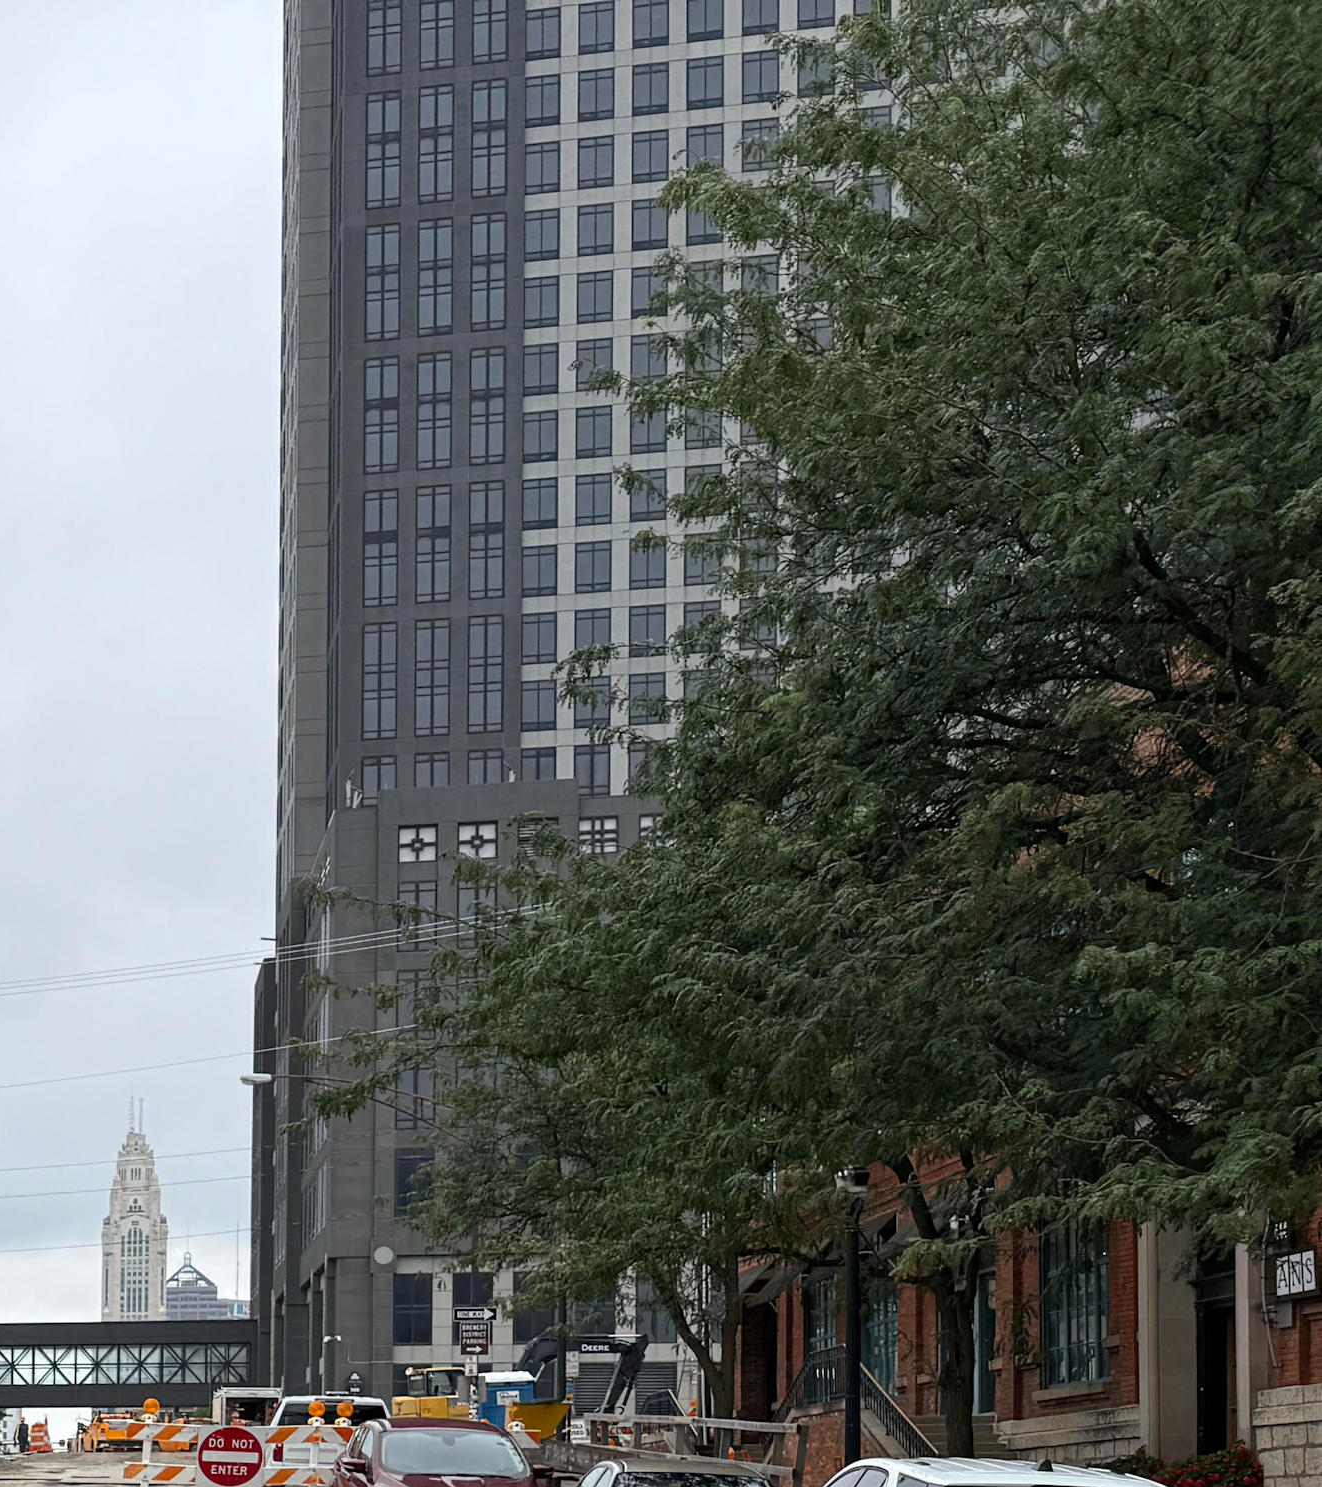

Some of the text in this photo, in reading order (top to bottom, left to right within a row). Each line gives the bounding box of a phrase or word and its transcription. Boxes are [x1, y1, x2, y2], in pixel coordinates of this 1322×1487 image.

[581, 1343, 610, 1351] DEERE
[208, 1437, 255, 1449] DO NOT
[210, 1464, 248, 1475] ENTER
